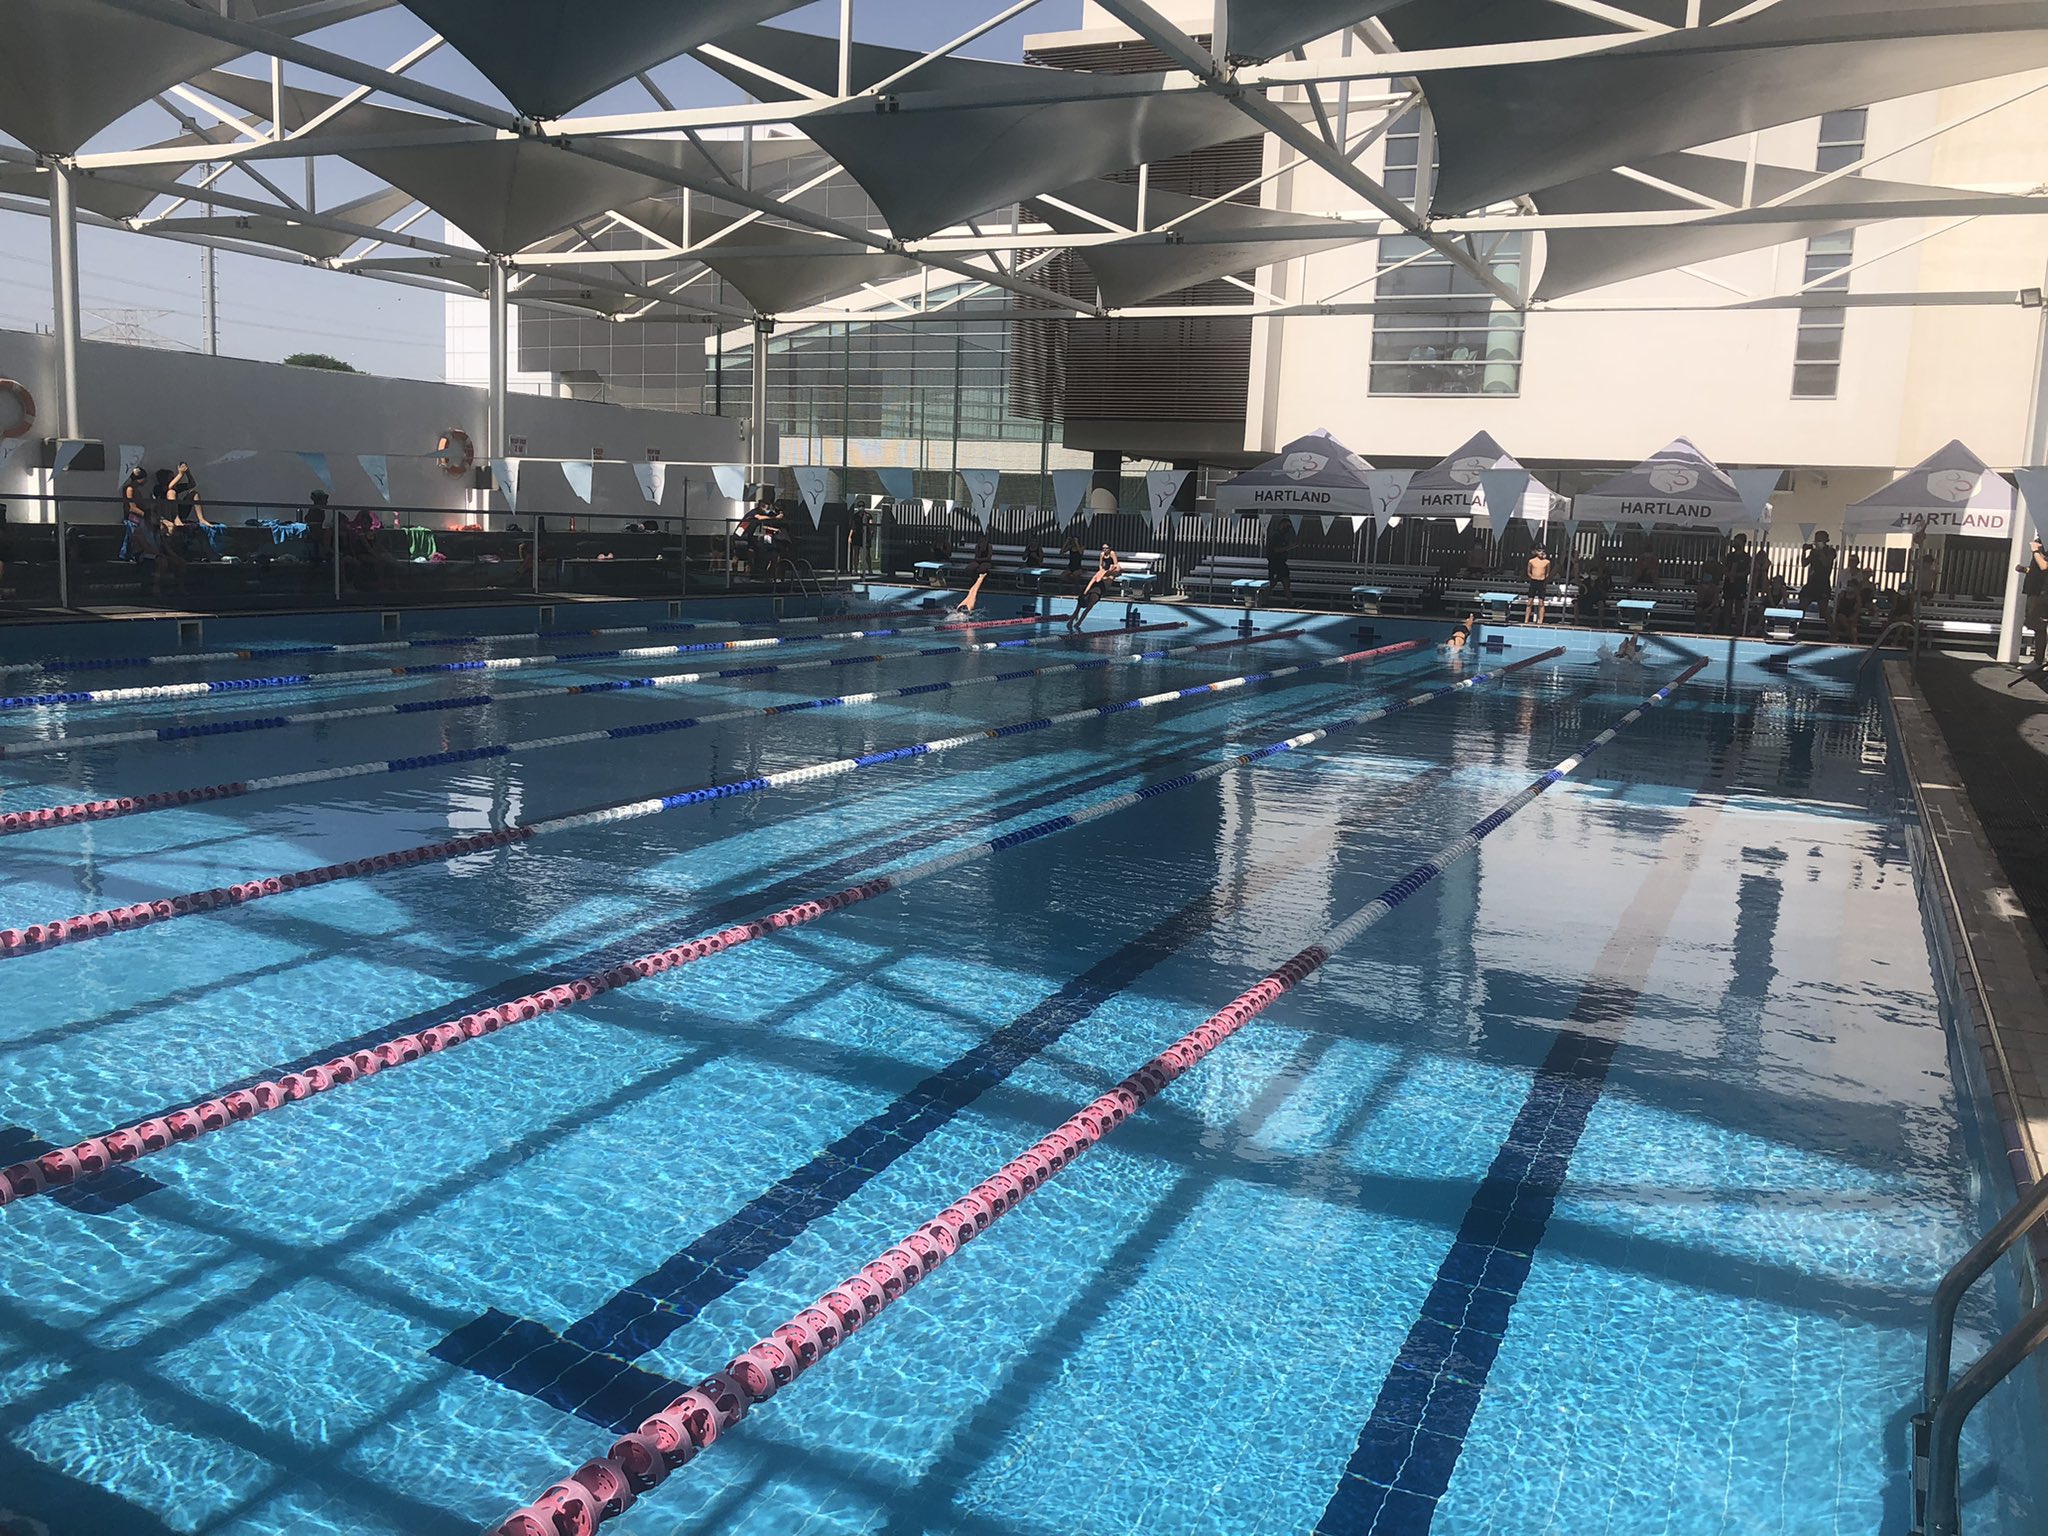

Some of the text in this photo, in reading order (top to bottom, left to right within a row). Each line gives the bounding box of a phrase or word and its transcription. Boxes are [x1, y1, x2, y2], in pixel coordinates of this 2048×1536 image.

[1254, 490, 1331, 503] HARTLAND
[1421, 493, 1487, 507] HARTLA
[1620, 502, 1712, 518] HARTLAND
[1900, 512, 2004, 529] HARTLAND
